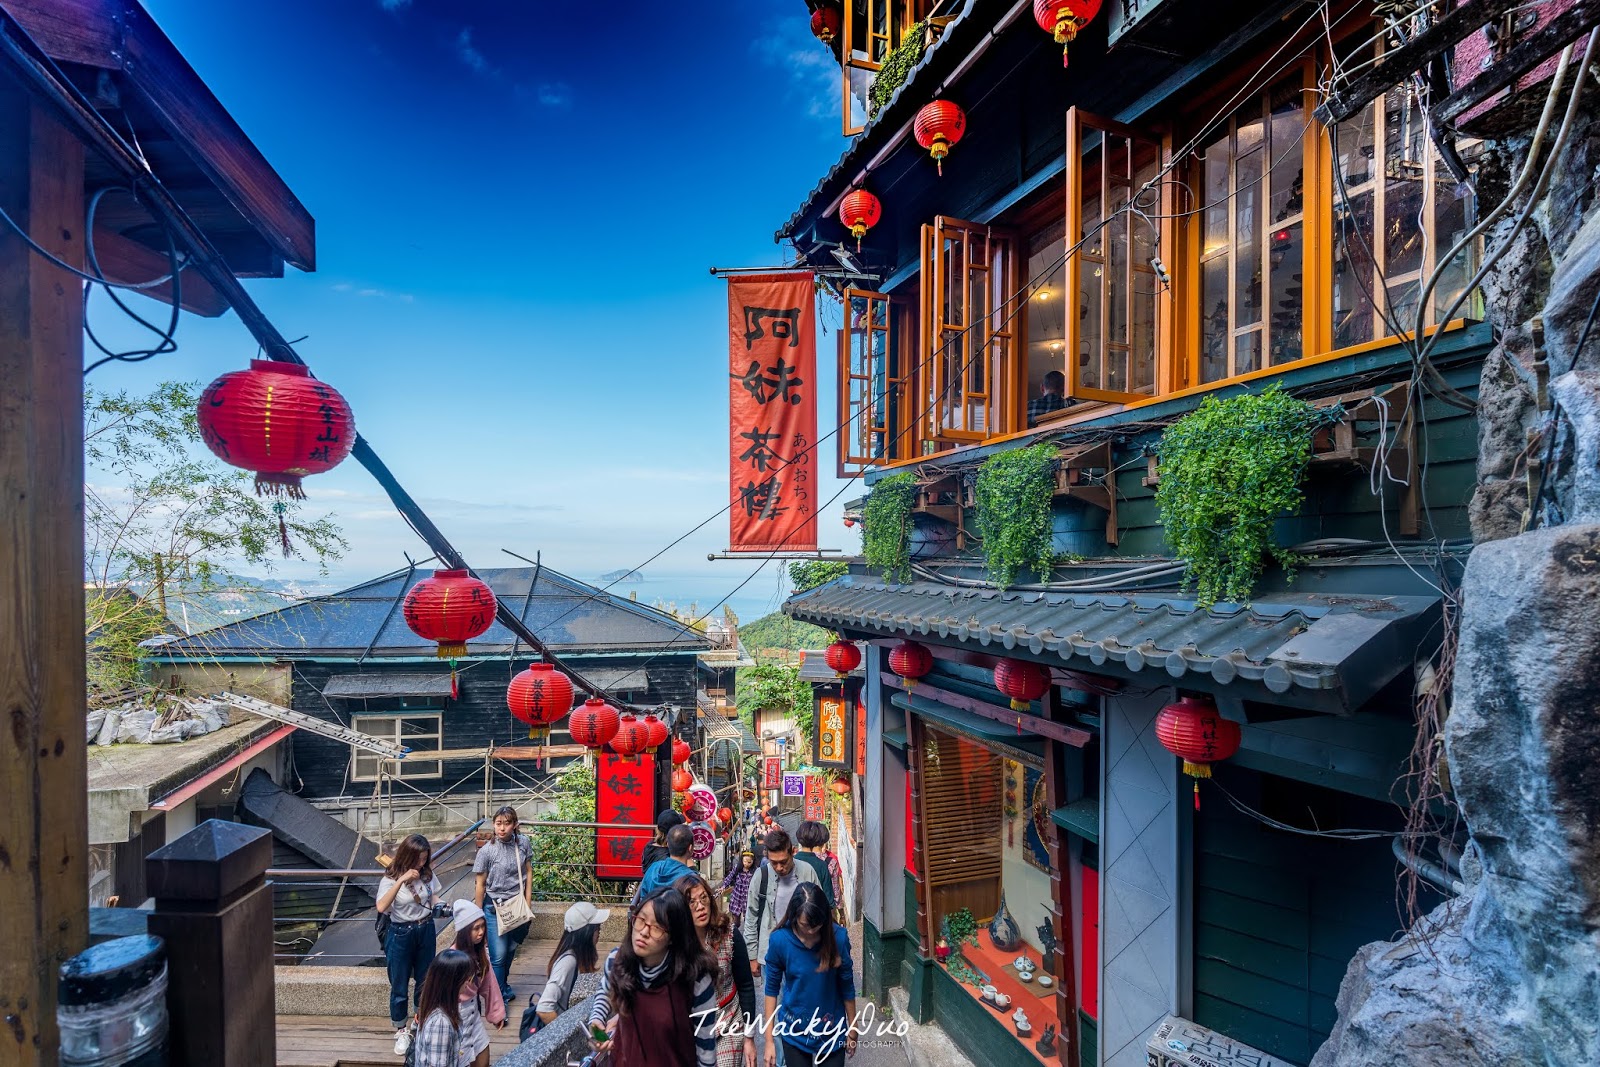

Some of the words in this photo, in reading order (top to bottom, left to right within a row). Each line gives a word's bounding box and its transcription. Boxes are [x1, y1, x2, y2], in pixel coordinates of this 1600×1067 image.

[730, 306, 803, 521] 阿妹茶樓
[792, 432, 809, 516] あめおちゃ
